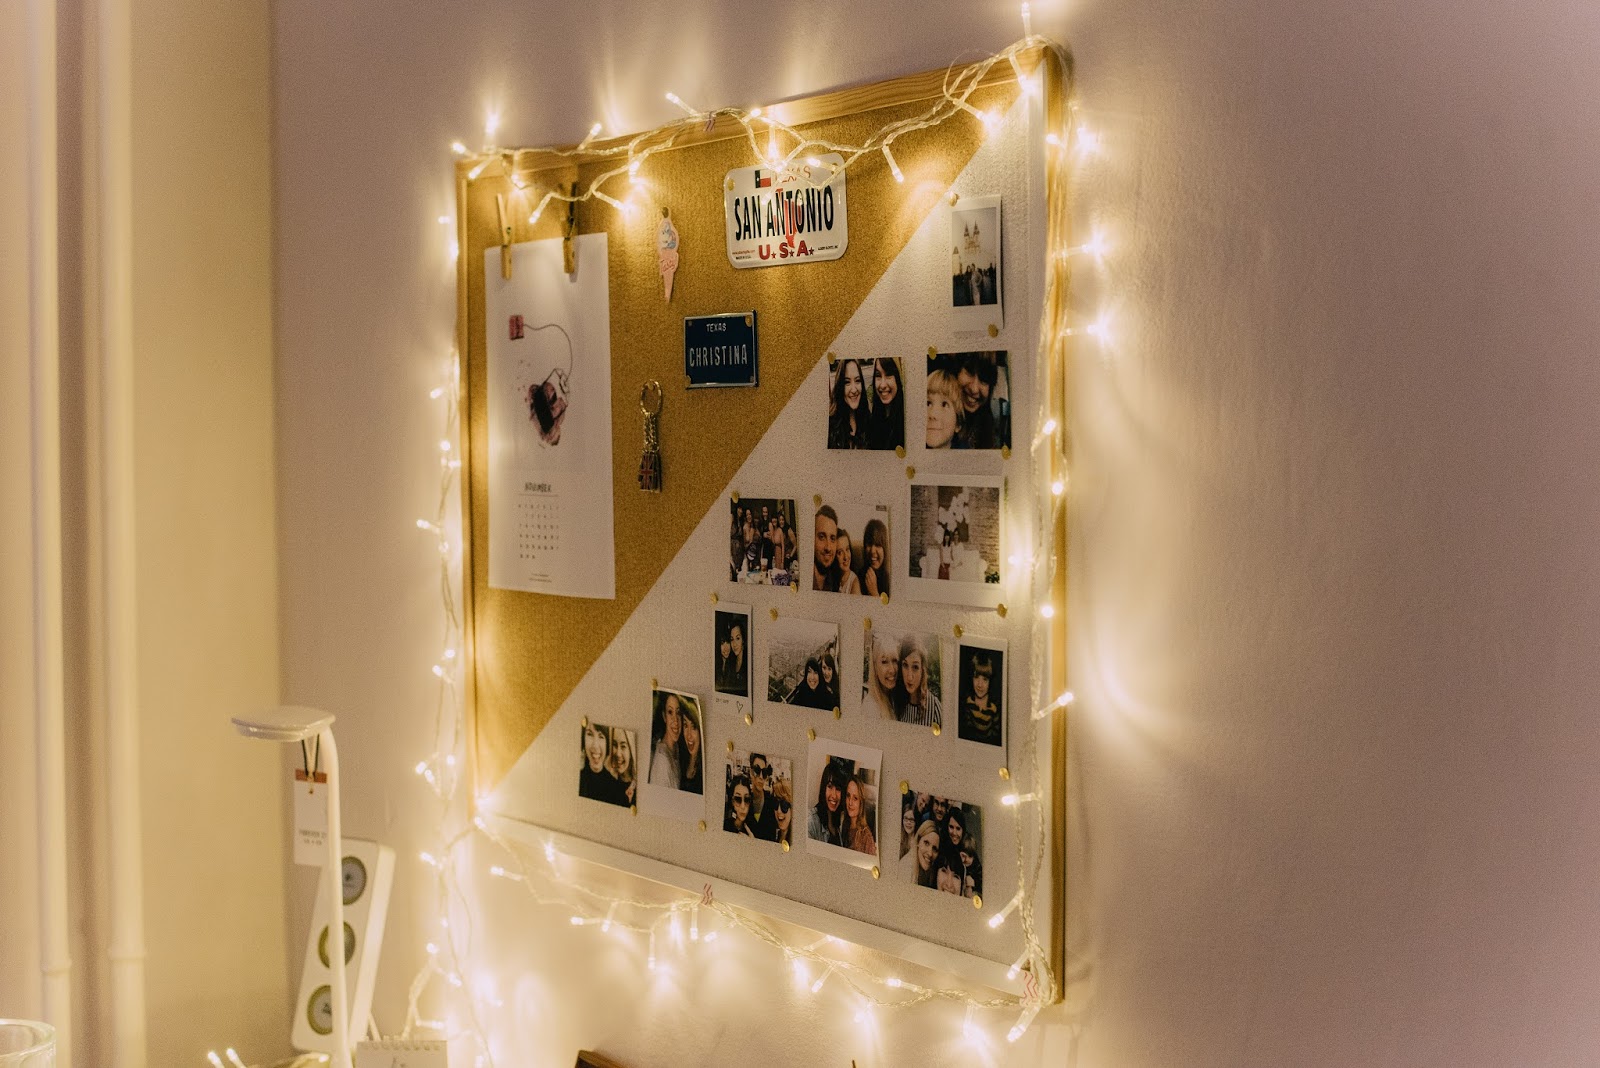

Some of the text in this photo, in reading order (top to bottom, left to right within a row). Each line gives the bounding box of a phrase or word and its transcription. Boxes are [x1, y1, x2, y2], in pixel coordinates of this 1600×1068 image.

[734, 184, 834, 241] SAN ANTONIO
[706, 322, 727, 333] TEXAS
[689, 343, 748, 368] CHRISTINA
